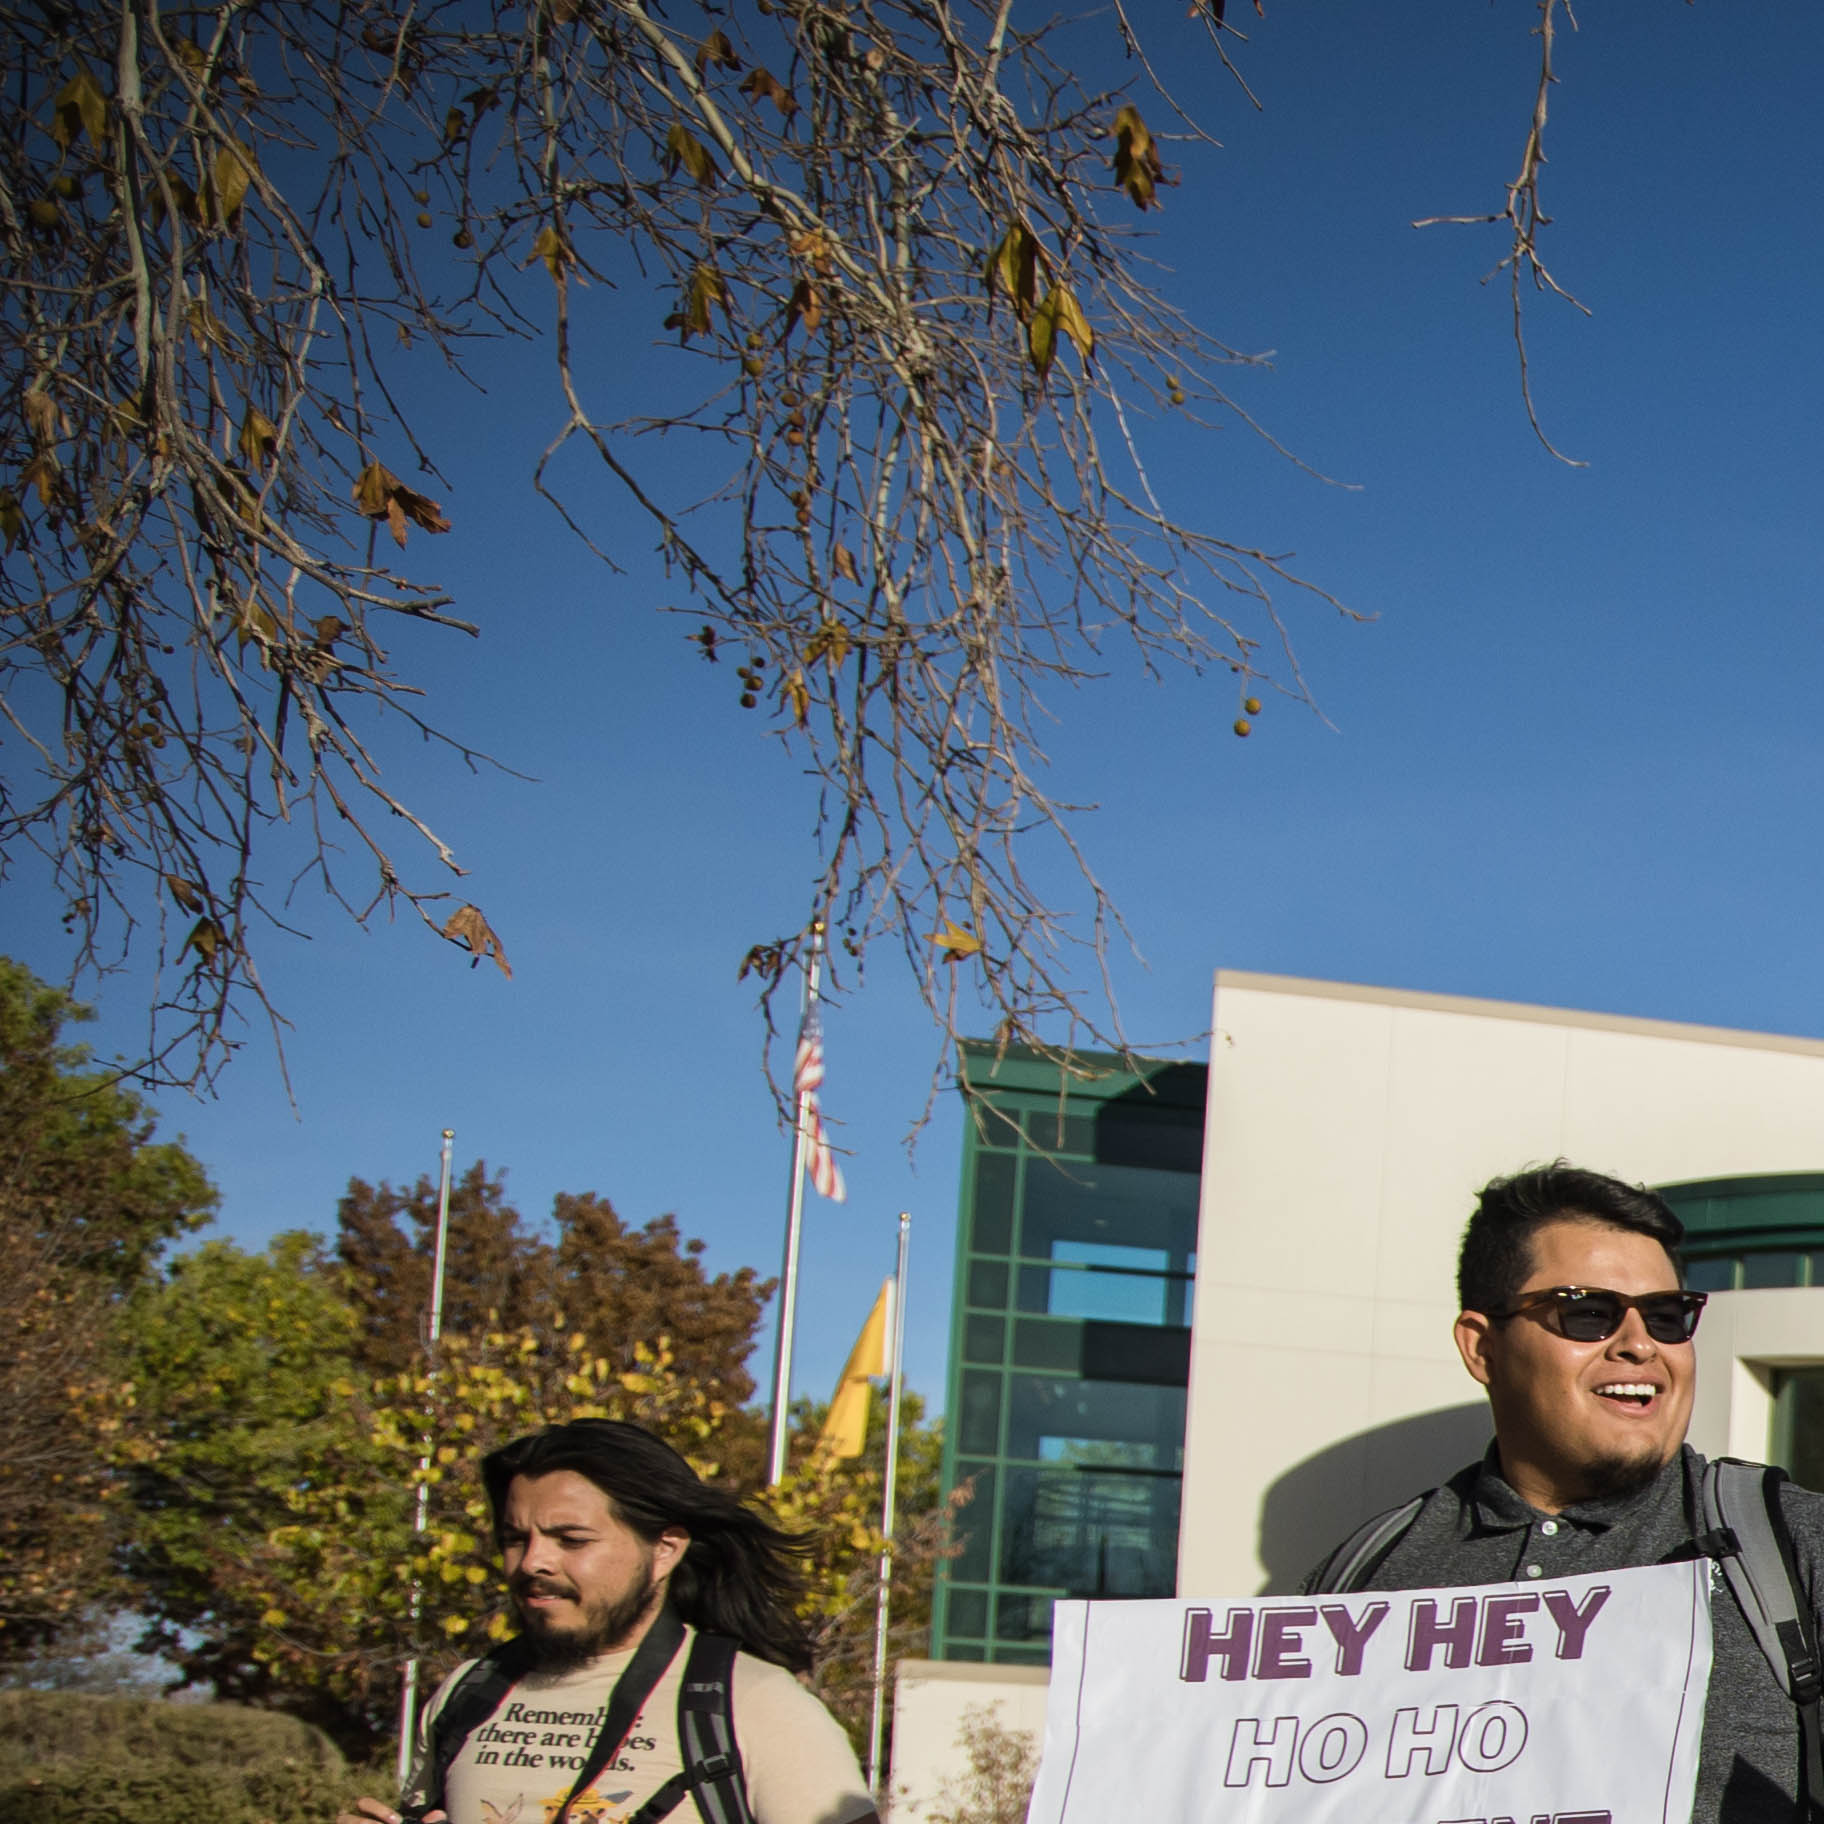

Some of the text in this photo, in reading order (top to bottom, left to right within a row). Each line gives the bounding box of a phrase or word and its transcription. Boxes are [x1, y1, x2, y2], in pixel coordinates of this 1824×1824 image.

[1179, 1585, 1612, 1683] HEY HEY
[474, 1744, 499, 1765] in
[503, 1747, 544, 1768] the
[476, 1722, 536, 1745] there
[540, 1730, 581, 1748] are
[1223, 1699, 1529, 1789] HO HO
